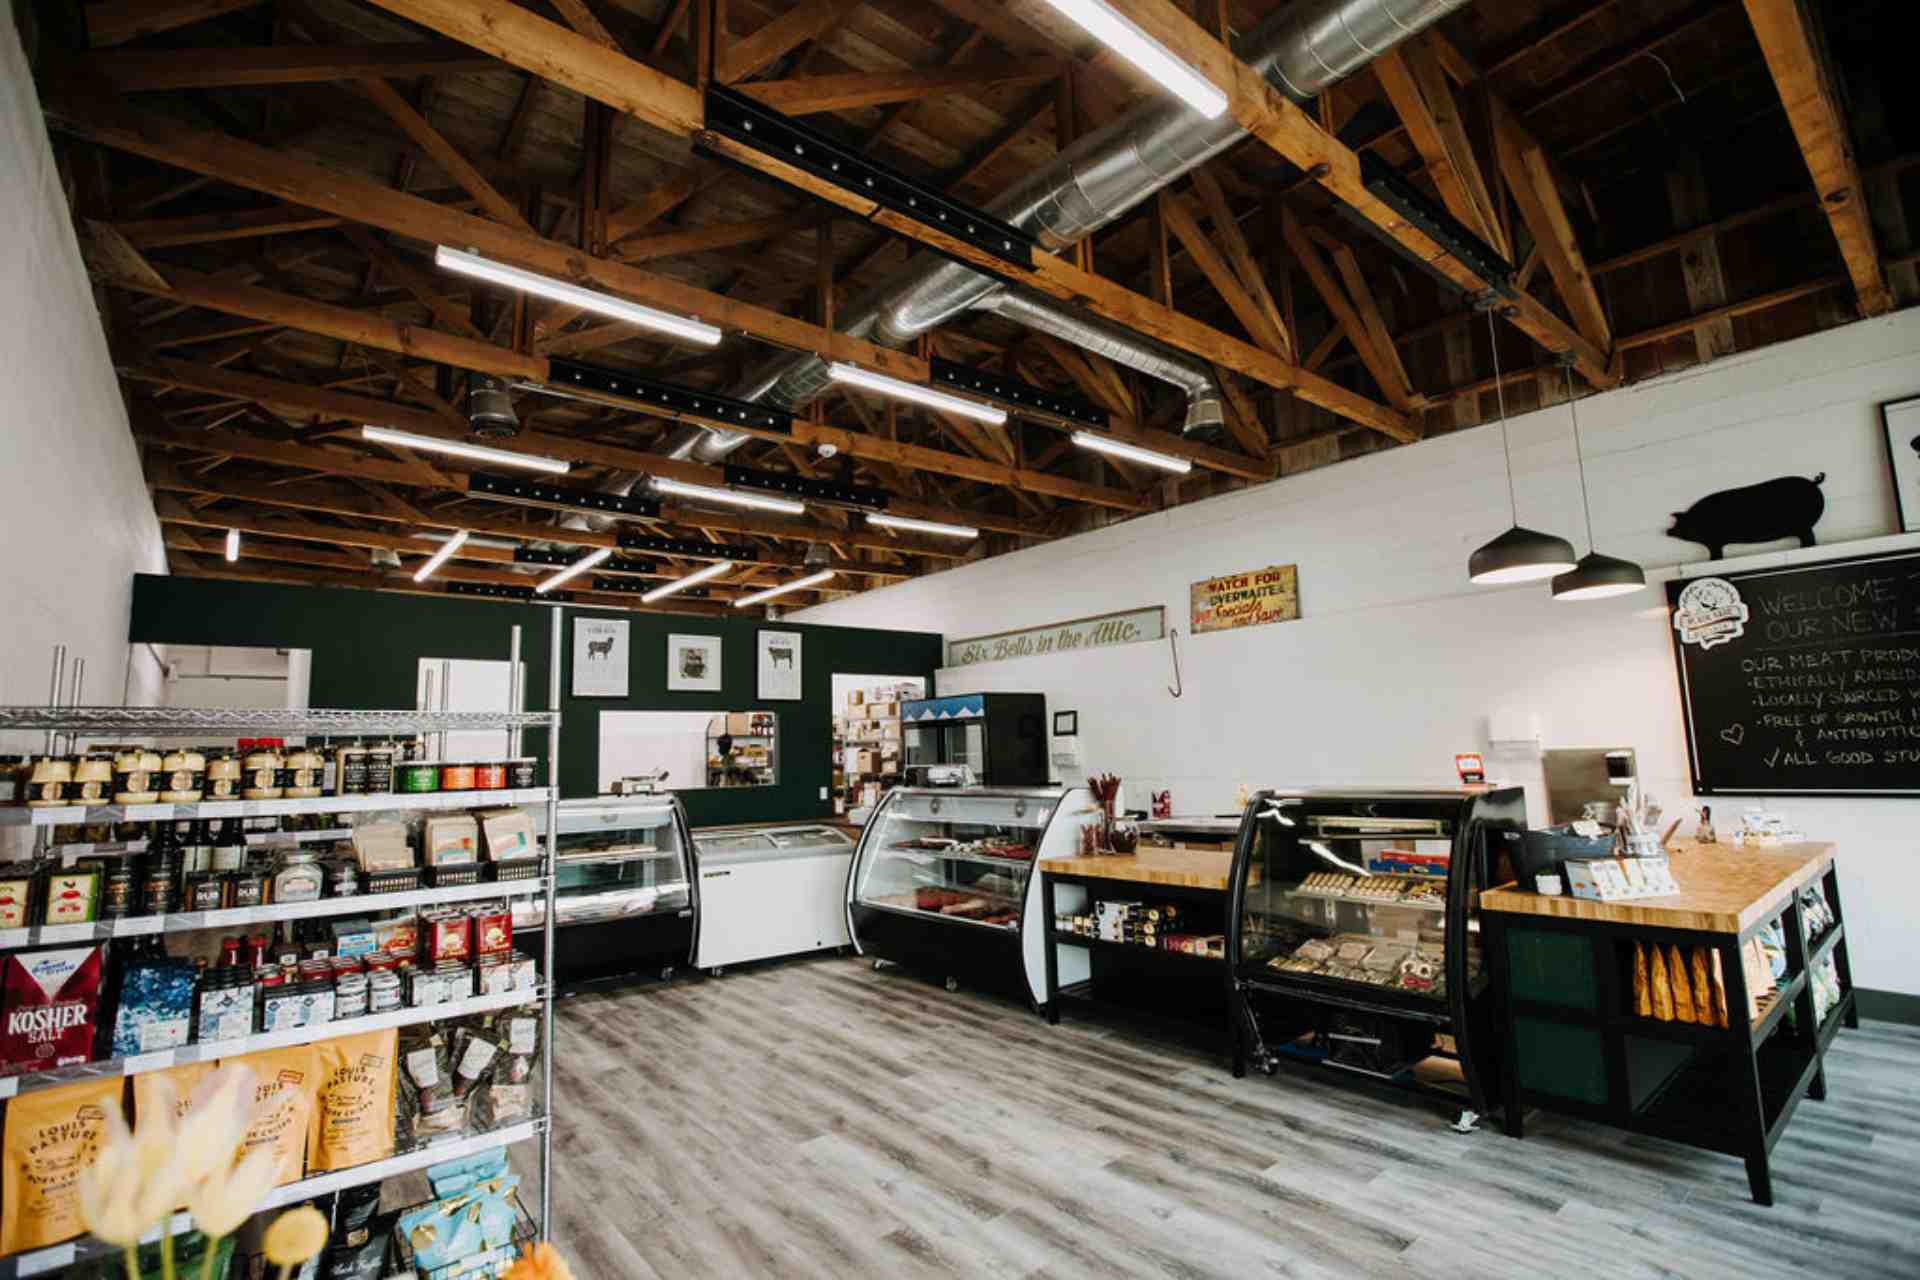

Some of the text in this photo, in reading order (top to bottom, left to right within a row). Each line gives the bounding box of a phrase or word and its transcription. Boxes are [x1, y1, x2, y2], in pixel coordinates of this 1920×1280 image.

[1208, 572, 1281, 592] WATCH FOR
[1758, 577, 1896, 616] WELCOME
[1766, 607, 1897, 642] OUR NEW
[1037, 632, 1053, 655] in
[1057, 628, 1083, 650] the
[1741, 656, 1784, 672] OUR
[1789, 650, 1854, 669] MEAT
[1758, 692, 1824, 709] LOCALLY
[1763, 713, 1804, 728] FREE
[1783, 751, 1817, 766] ALL
[1825, 751, 1874, 765] GOOD
[8, 1004, 89, 1036] KOSHER
[27, 1027, 63, 1044] SALT
[39, 1119, 87, 1139] LOUIS
